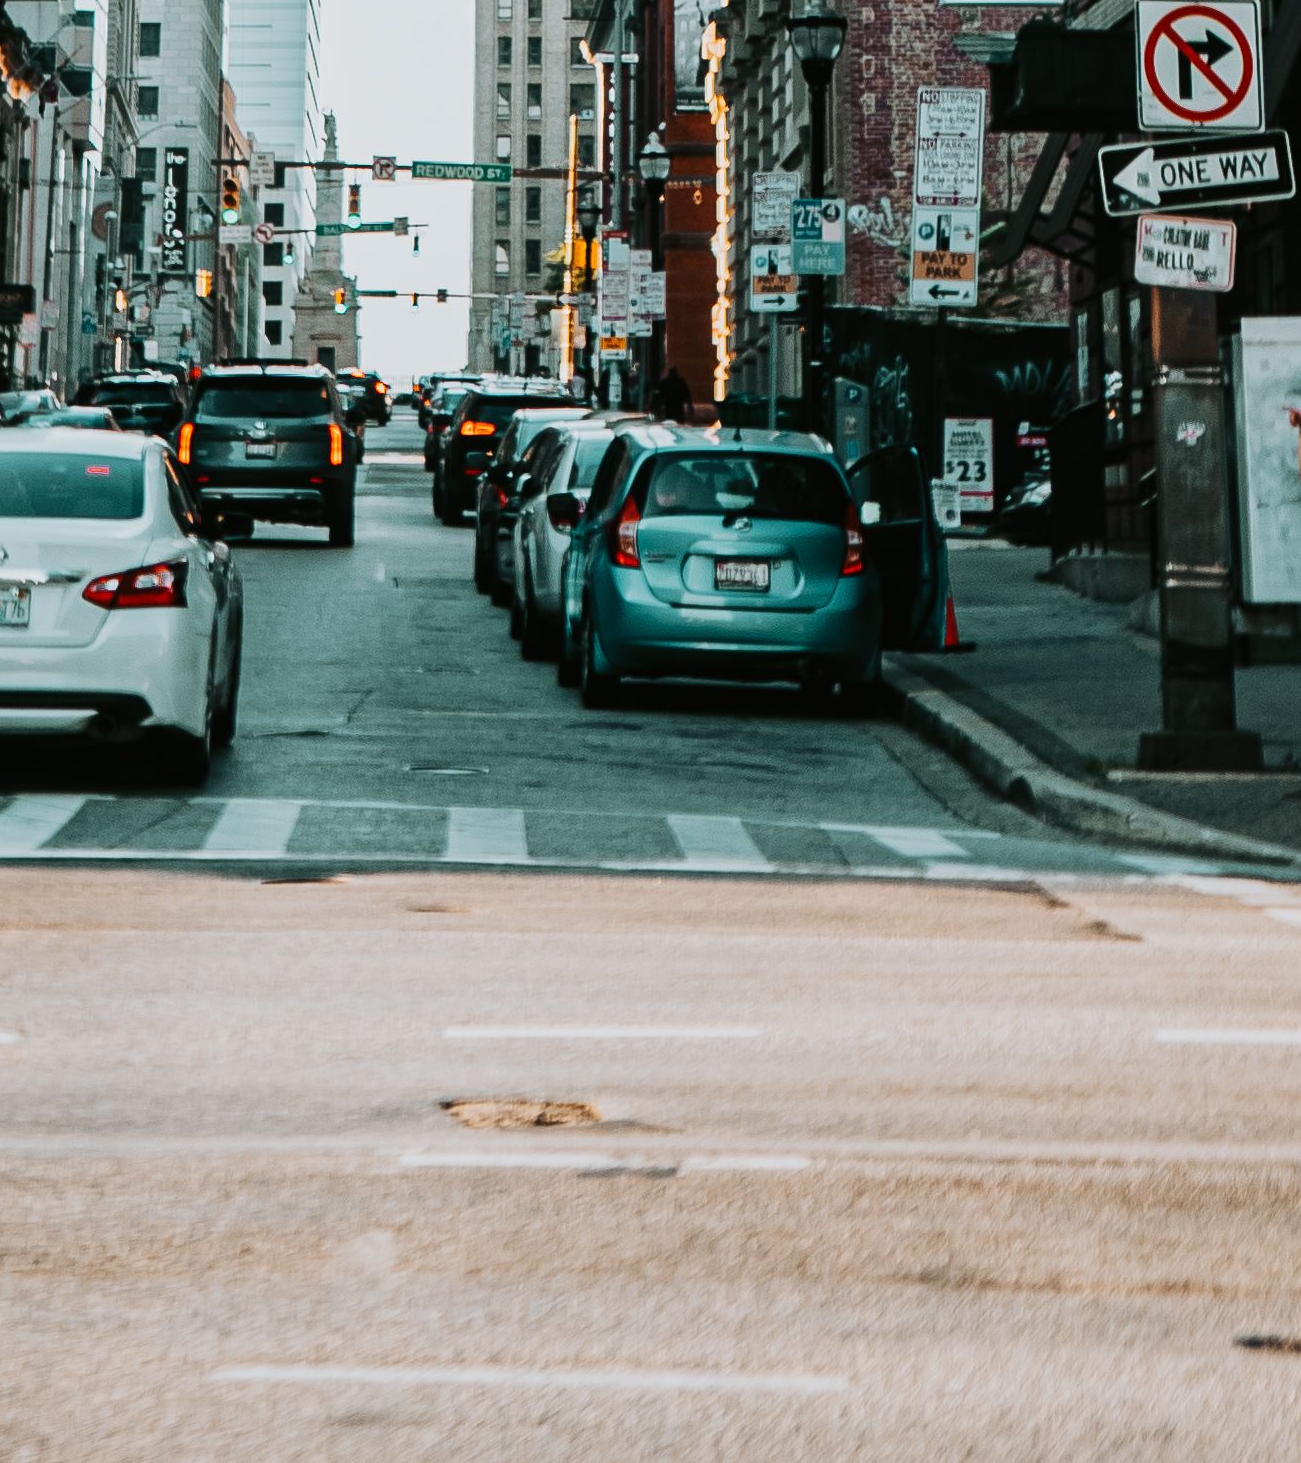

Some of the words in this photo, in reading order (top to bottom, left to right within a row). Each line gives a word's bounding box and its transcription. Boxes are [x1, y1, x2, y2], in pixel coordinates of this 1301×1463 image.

[922, 92, 939, 103] NO
[416, 164, 484, 180] REDWOOD
[1160, 159, 1212, 188] ONE
[1218, 152, 1267, 180] WAY
[921, 253, 946, 265] PAY
[951, 254, 967, 266] TO
[925, 266, 962, 279] PARK
[946, 460, 987, 482] $23
